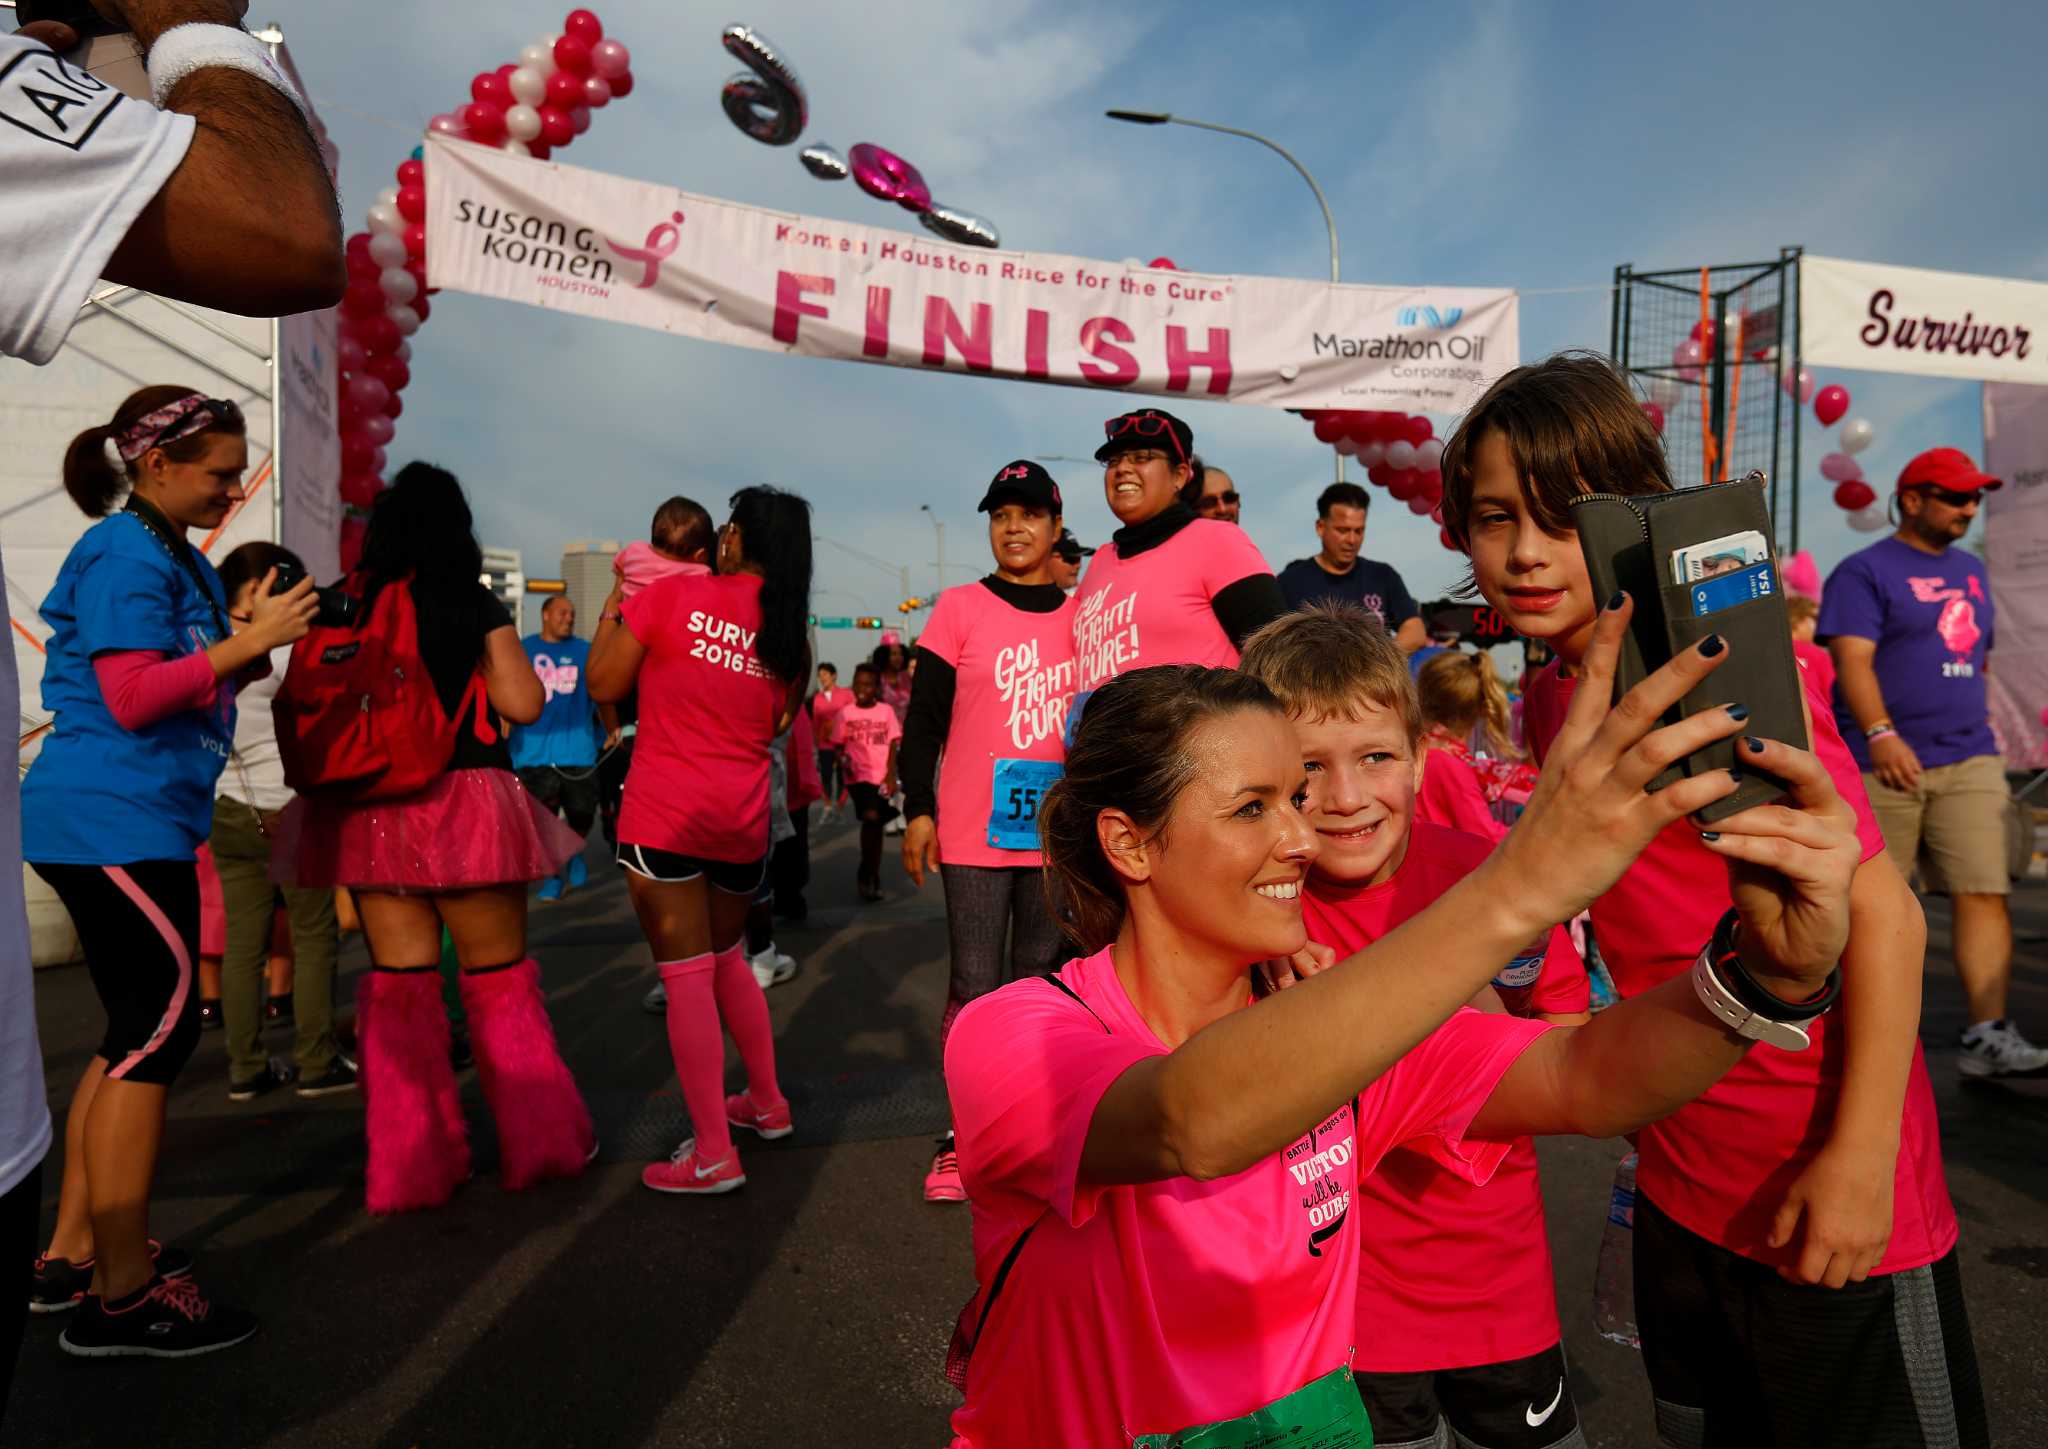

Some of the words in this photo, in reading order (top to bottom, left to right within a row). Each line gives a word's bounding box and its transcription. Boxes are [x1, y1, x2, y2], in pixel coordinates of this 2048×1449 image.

[776, 223, 869, 255] Komen
[880, 241, 989, 277] Houston
[1001, 262, 1064, 285] Race
[1076, 269, 1110, 291] for
[1120, 277, 1157, 297] the
[536, 275, 610, 299] HOUSTON
[772, 269, 1233, 395] FINISH
[1313, 332, 1444, 361] Marathon
[1448, 335, 1486, 362] Oil
[1861, 289, 2031, 360] Survivor
[689, 638, 744, 672] 2016
[995, 639, 1039, 701] GO!
[1302, 1179, 1328, 1208] will
[1326, 1174, 1342, 1196] be
